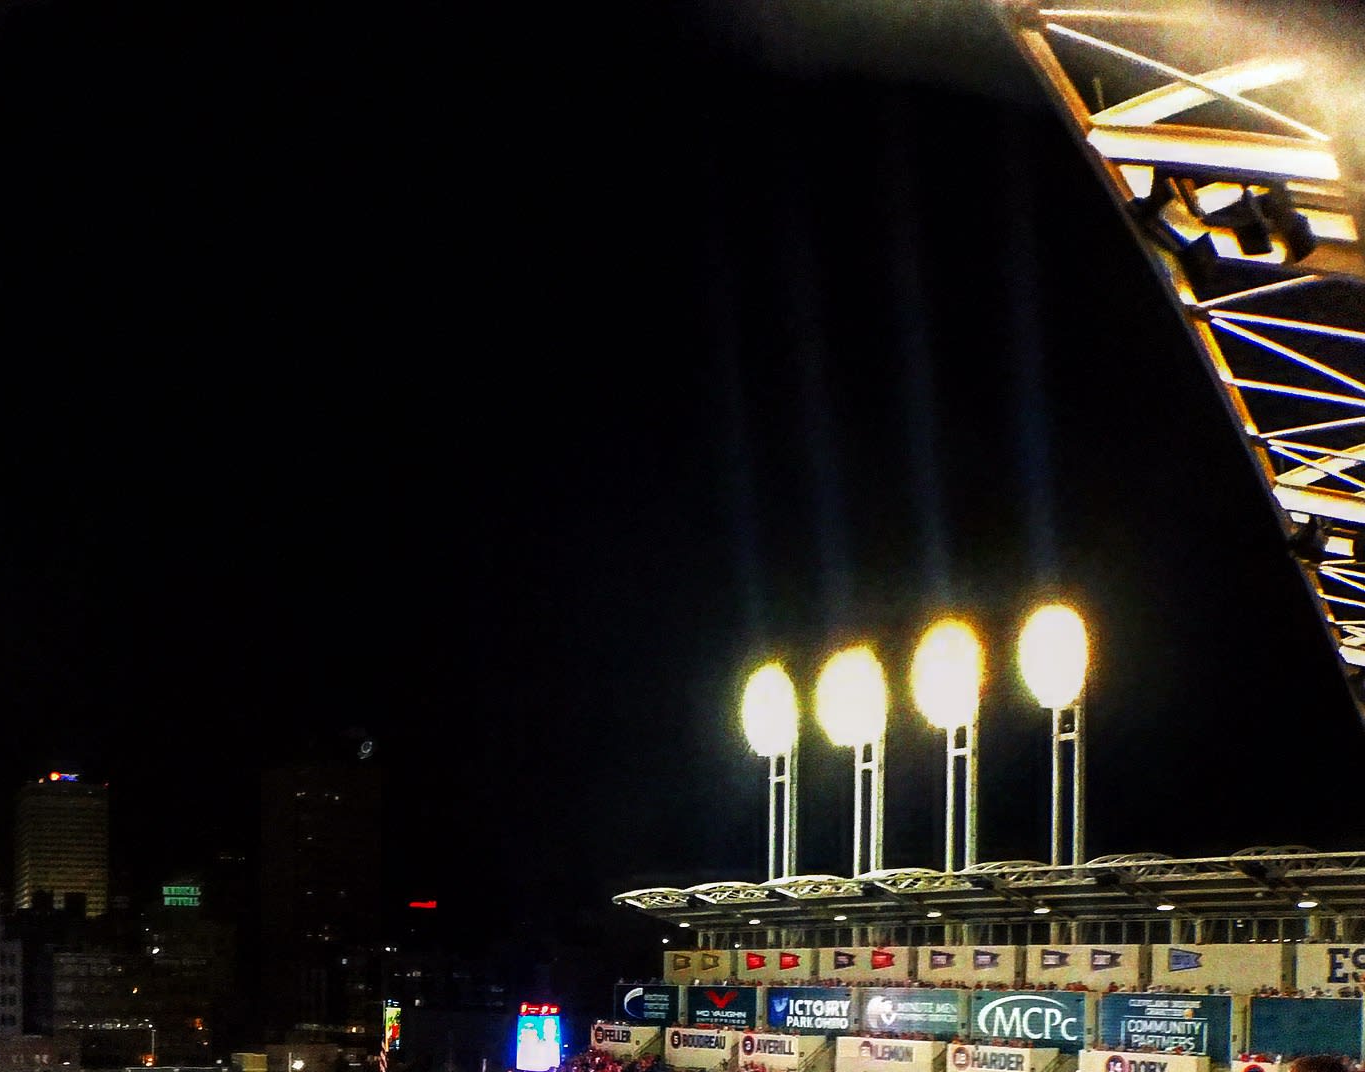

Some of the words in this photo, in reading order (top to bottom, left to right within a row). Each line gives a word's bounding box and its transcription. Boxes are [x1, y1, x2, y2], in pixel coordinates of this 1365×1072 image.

[786, 1015, 814, 1029] PARK
[1127, 1019, 1202, 1035] COMMUNITY
[756, 1038, 795, 1055] AVERILL
[1131, 1034, 1196, 1052] PARTNERS
[874, 1044, 914, 1062] LEMON
[971, 1050, 1024, 1071] HARDER
